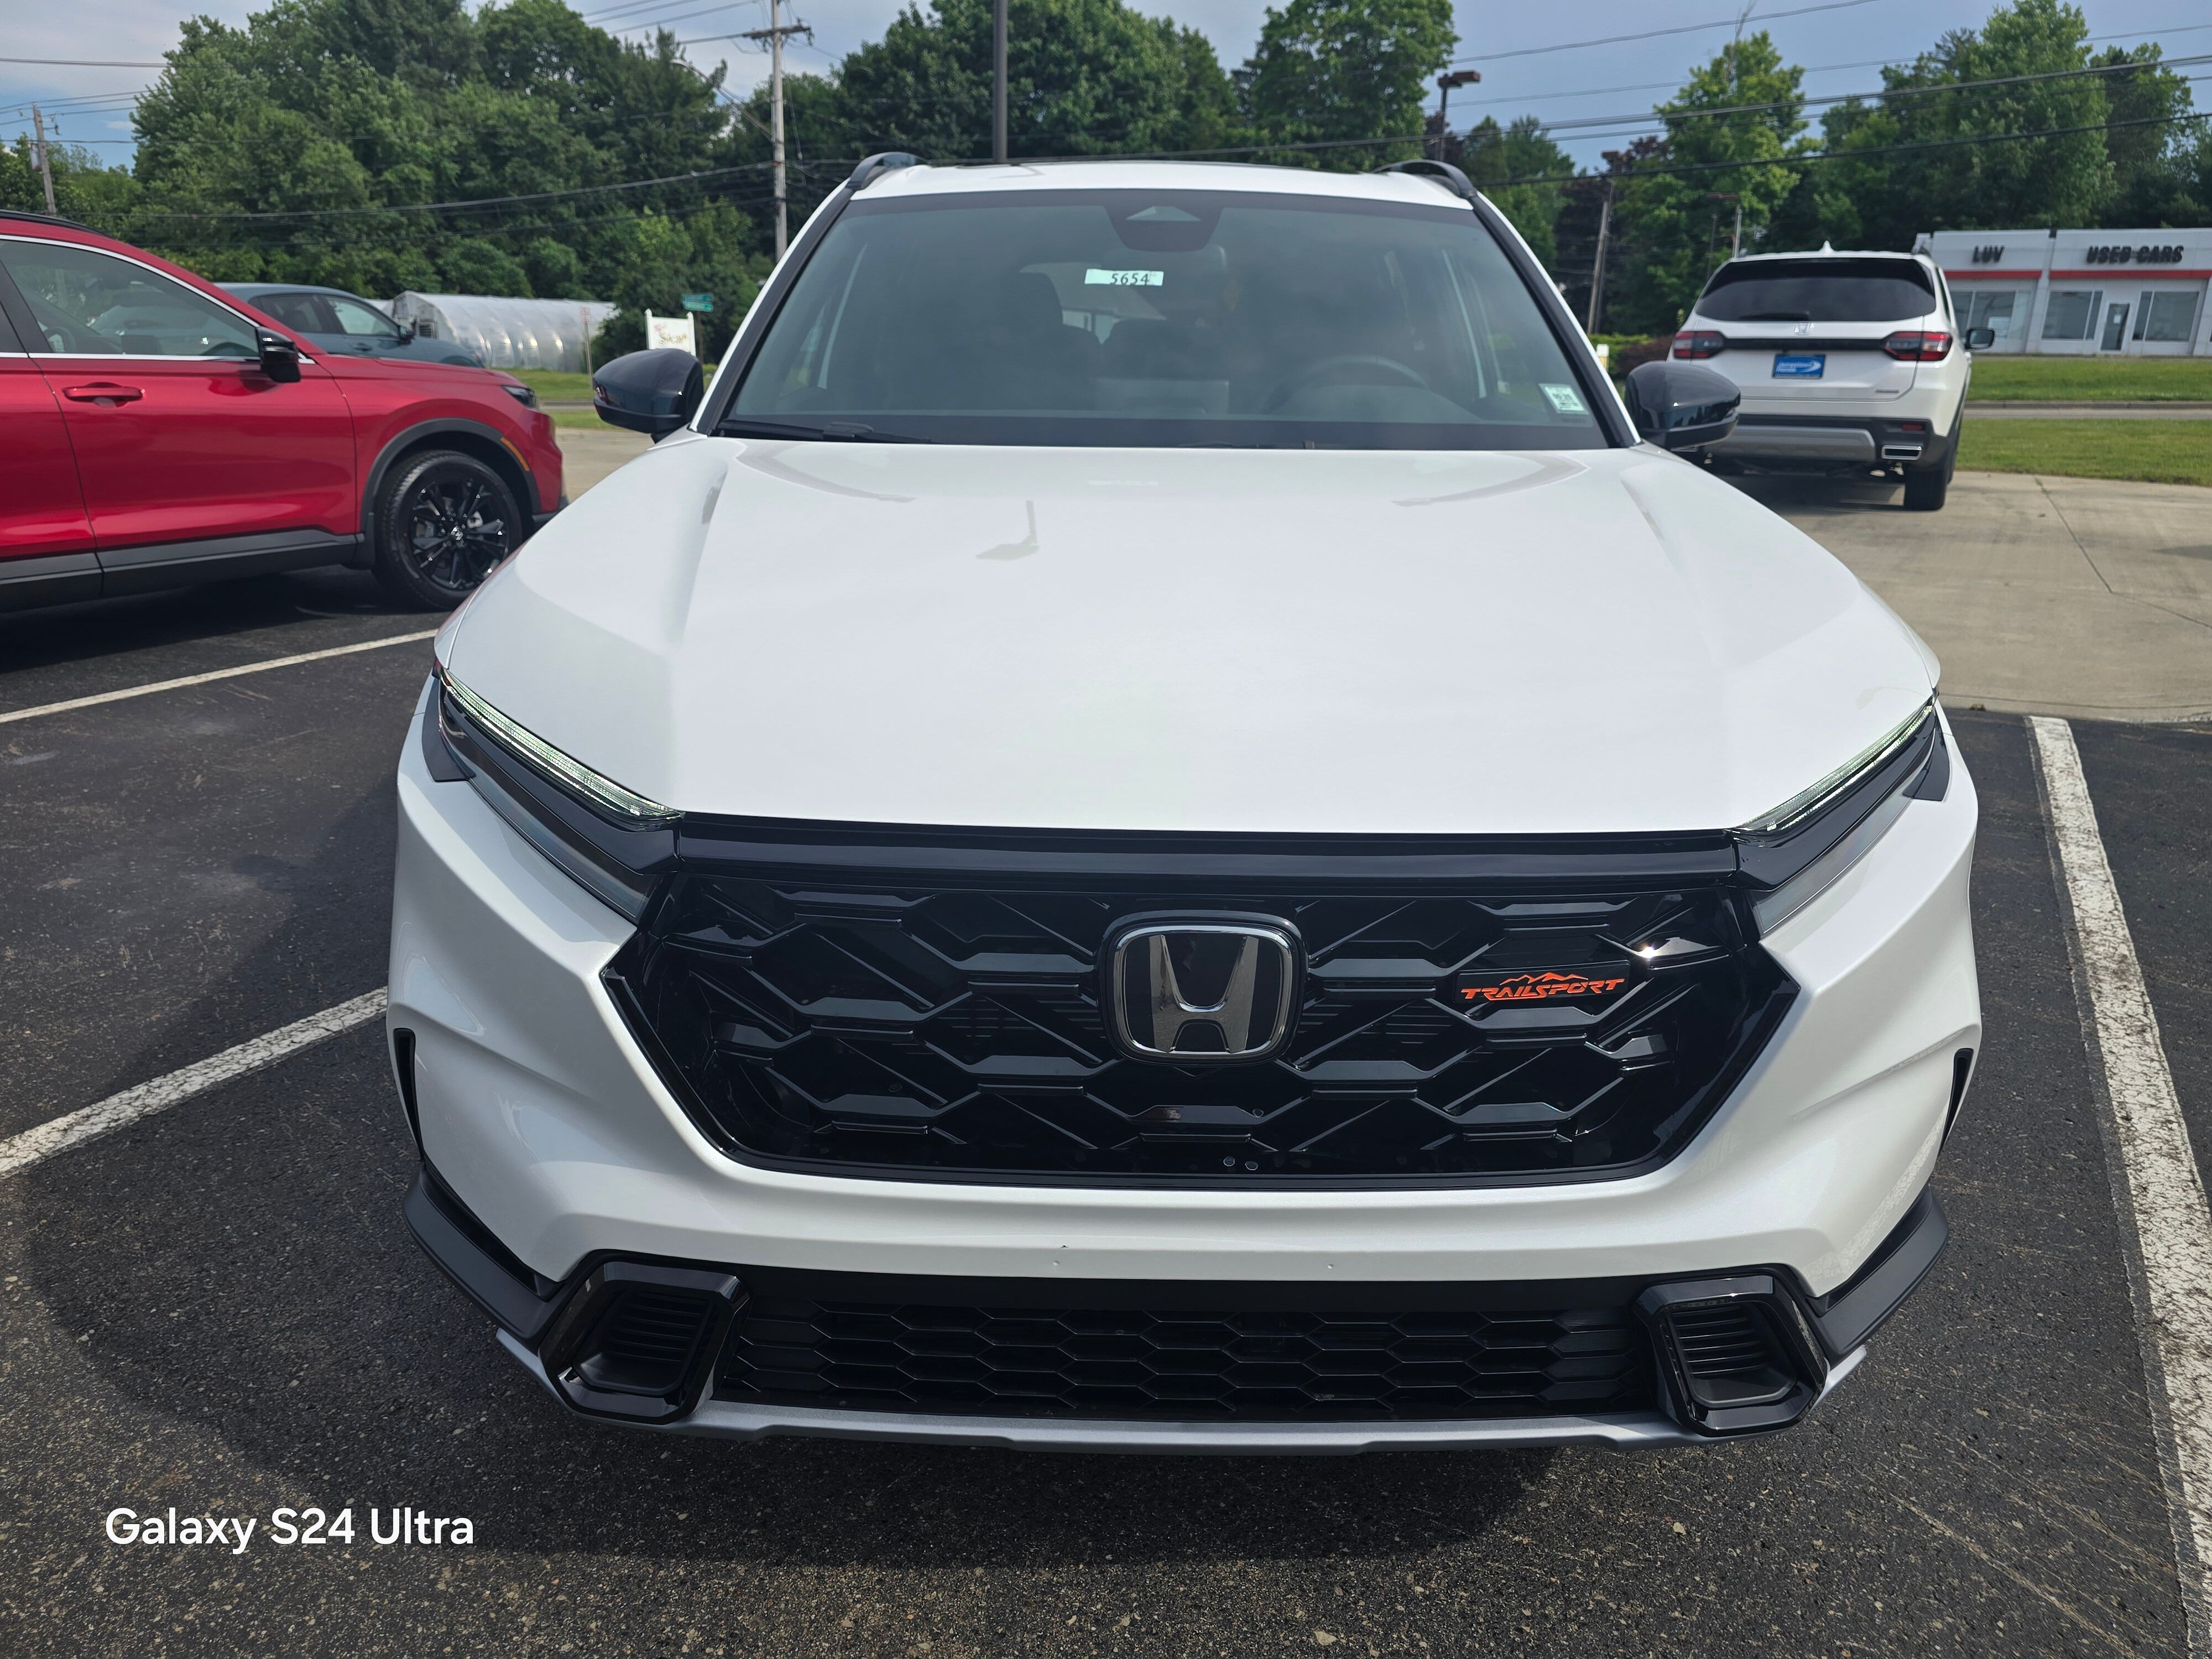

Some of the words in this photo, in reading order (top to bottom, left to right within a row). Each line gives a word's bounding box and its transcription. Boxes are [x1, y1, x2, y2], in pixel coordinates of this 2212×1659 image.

[1973, 245, 2005, 264] LUV
[2086, 246, 2132, 264] USED
[2136, 245, 2184, 264] CARS
[1110, 273, 1149, 285] 5654
[1460, 978, 1625, 1001] TRAILSPORT
